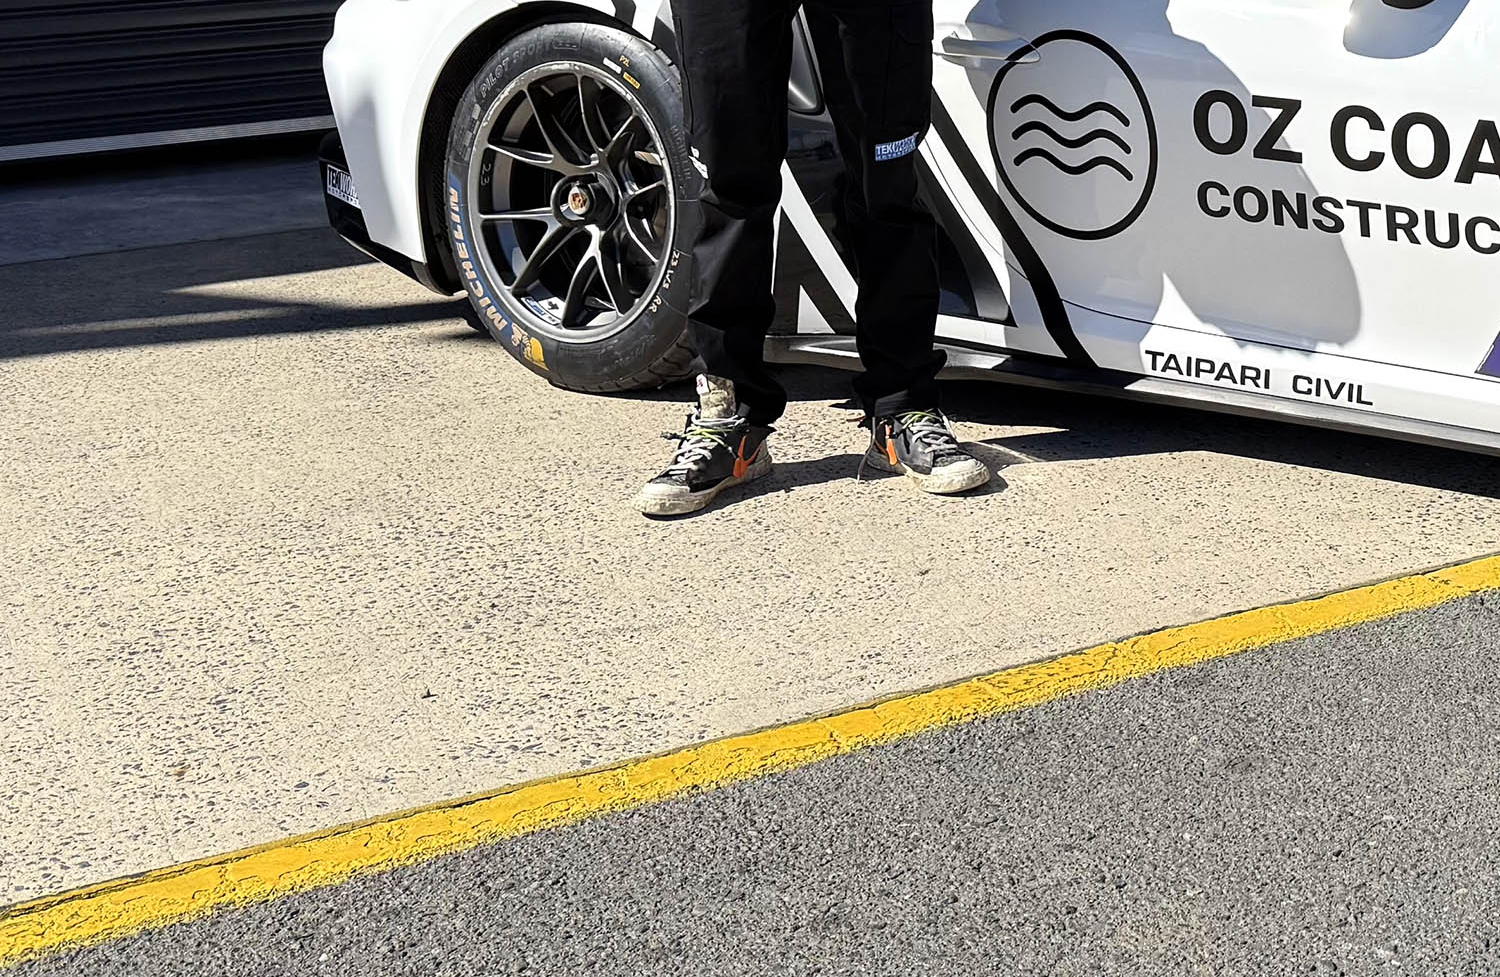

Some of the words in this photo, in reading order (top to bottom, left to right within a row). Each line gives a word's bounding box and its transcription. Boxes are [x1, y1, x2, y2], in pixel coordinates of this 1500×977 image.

[1191, 89, 1302, 165] OZ
[449, 186, 508, 331] MICHELIN
[1144, 350, 1271, 390] TAIPARI
[1291, 374, 1374, 406] CIVIL
